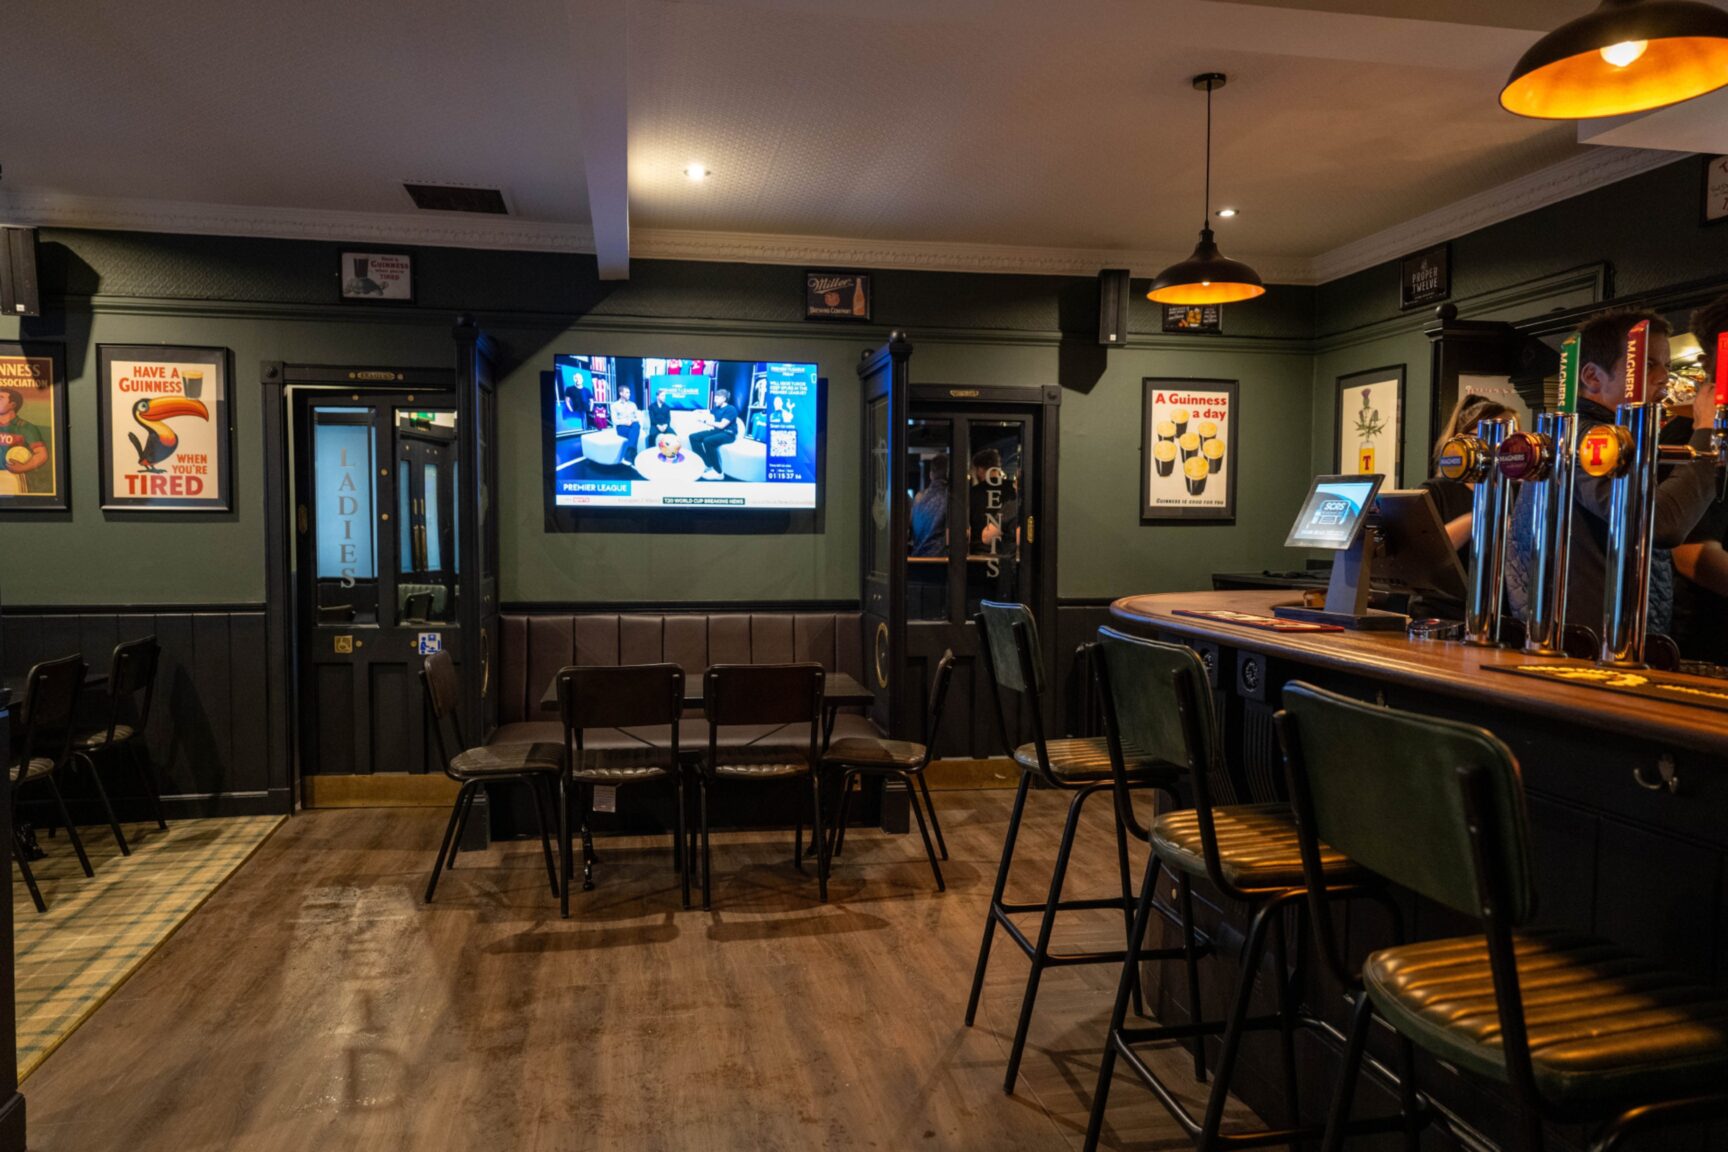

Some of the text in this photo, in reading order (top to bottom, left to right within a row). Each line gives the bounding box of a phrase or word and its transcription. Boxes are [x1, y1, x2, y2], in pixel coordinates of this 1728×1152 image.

[370, 260, 409, 269] GUINNESS
[1412, 266, 1438, 282] PROPER
[808, 277, 852, 294] Miller
[1412, 278, 1438, 294] TWELVE
[133, 366, 179, 379] HAVE A
[1624, 340, 1637, 398] MAGNERS
[119, 378, 182, 393] GUINNESS
[1558, 352, 1568, 407] MAGNERS
[1155, 393, 1227, 406] A Guinness
[1203, 409, 1226, 422] day
[176, 454, 207, 464] WHEN
[1499, 454, 1525, 462] MAGNERS
[1586, 438, 1608, 466] T
[172, 464, 208, 475] YOU'RE
[1363, 455, 1371, 470] T
[124, 474, 204, 496] TIRED
[338, 447, 358, 589] LADIES
[985, 466, 1004, 578] GENTS
